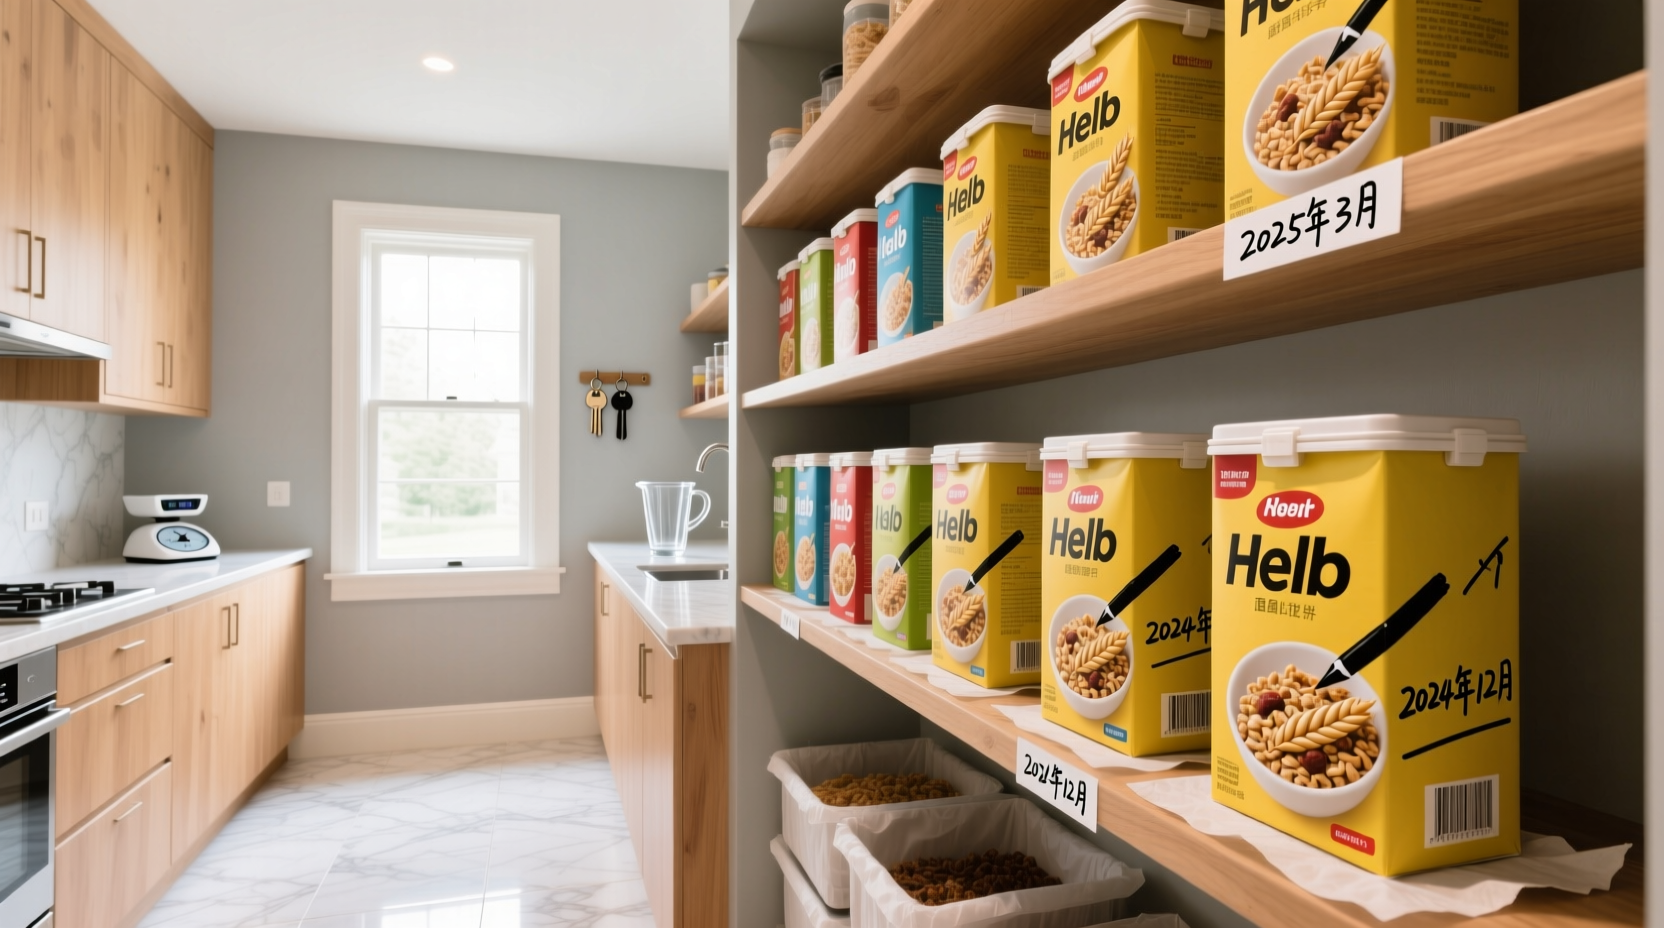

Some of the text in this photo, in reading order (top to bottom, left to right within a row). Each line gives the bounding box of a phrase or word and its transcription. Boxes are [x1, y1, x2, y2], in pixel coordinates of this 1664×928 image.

[1058, 90, 1120, 156] Helb
[947, 174, 985, 221] Helb
[1240, 180, 1377, 261] 2025年3月
[936, 508, 978, 543] Helb
[1049, 517, 1117, 563] Helb
[1226, 533, 1351, 599] Helb
[1399, 658, 1512, 720] 2024年12月
